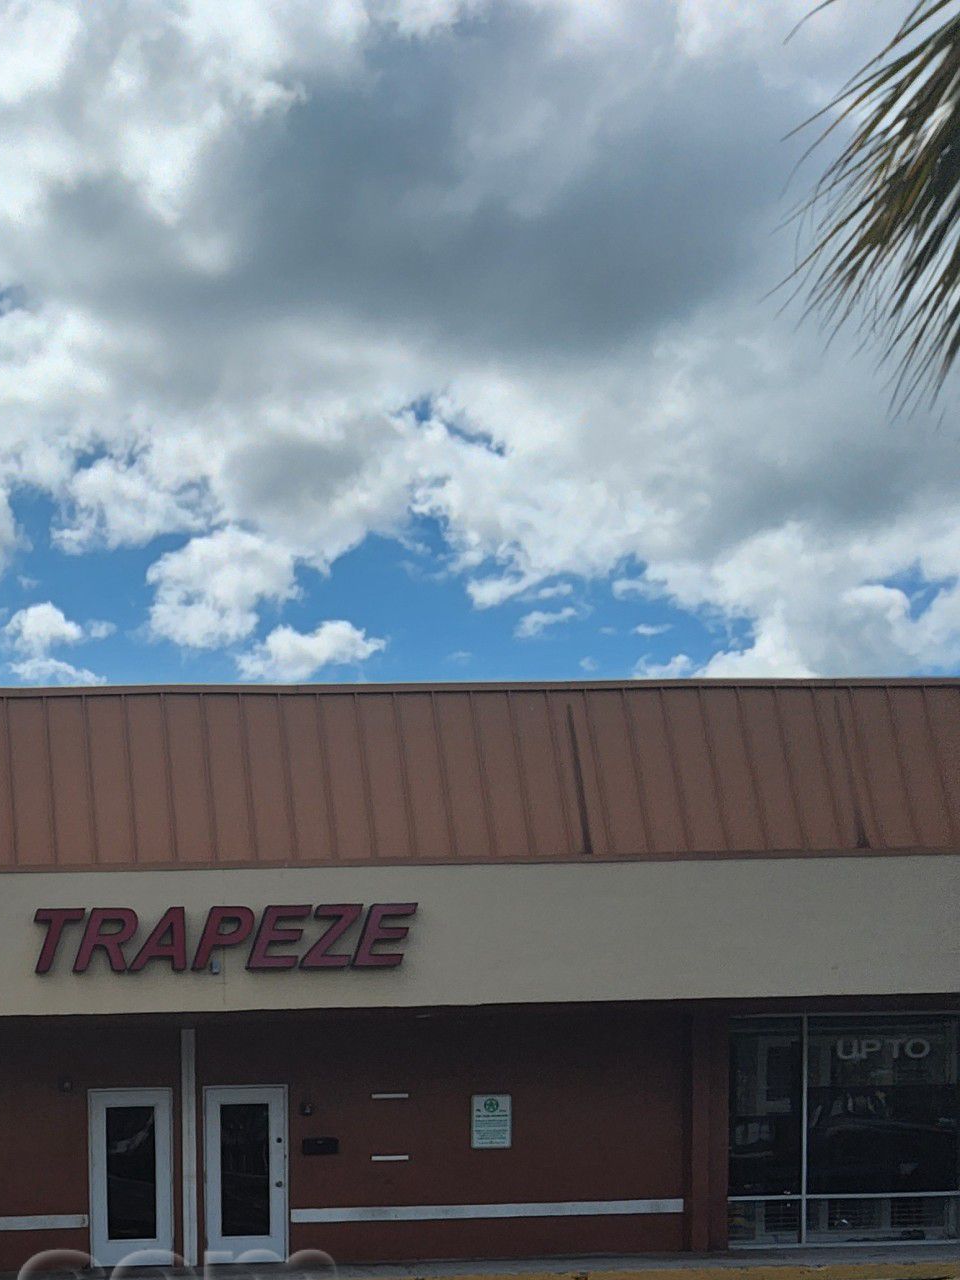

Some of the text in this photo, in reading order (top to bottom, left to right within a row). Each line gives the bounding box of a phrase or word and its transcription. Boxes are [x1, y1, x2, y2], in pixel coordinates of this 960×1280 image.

[34, 902, 418, 974] TRAPEZE
[836, 1037, 930, 1059] UP TO
